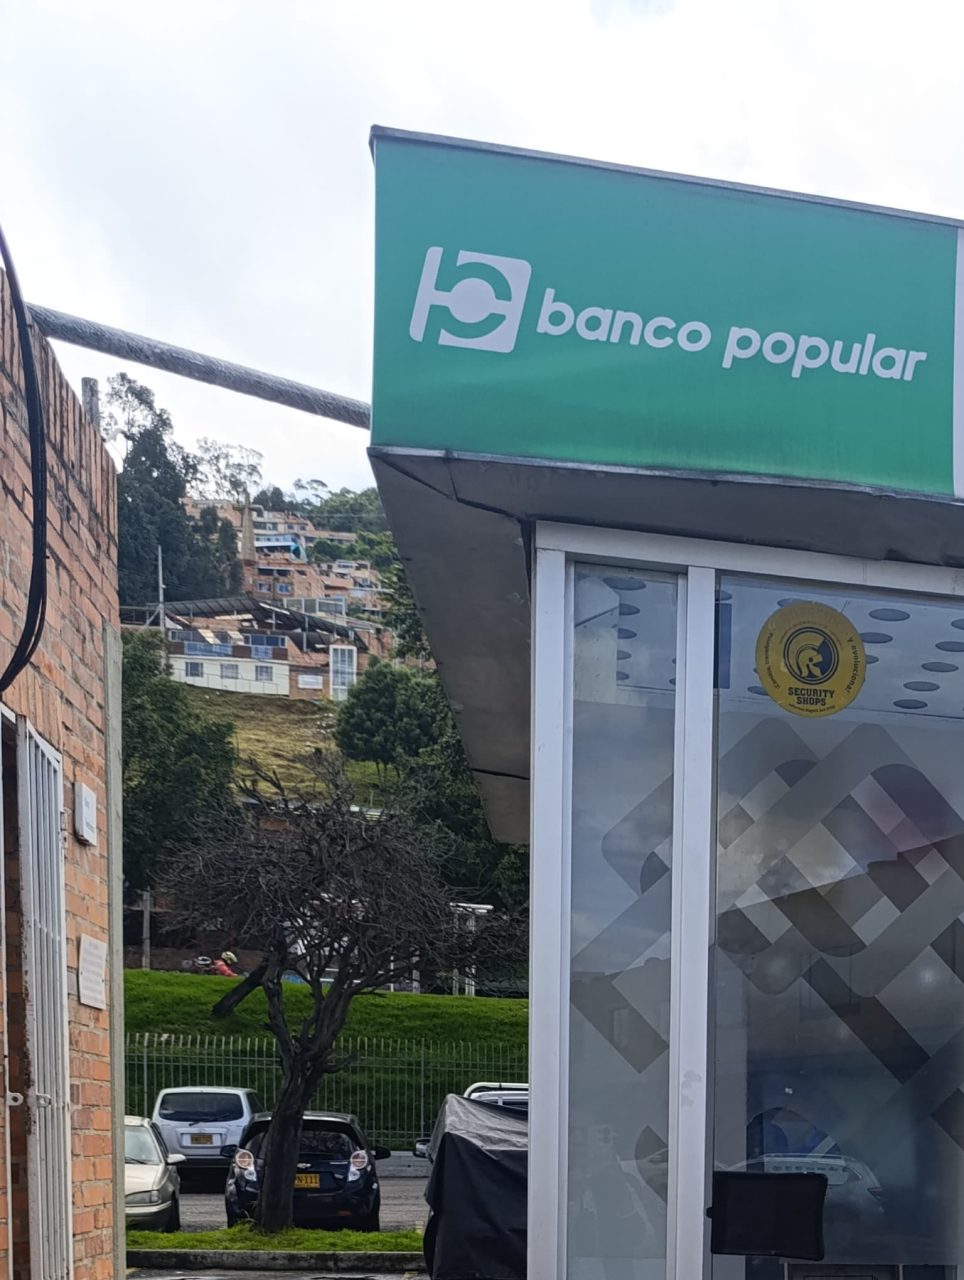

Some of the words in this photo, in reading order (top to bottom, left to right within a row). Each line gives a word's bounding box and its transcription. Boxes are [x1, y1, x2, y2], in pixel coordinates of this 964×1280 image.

[537, 287, 712, 352] banco
[722, 326, 928, 382] popular
[788, 686, 835, 699] SECURITY
[796, 696, 827, 706] SHOPS
